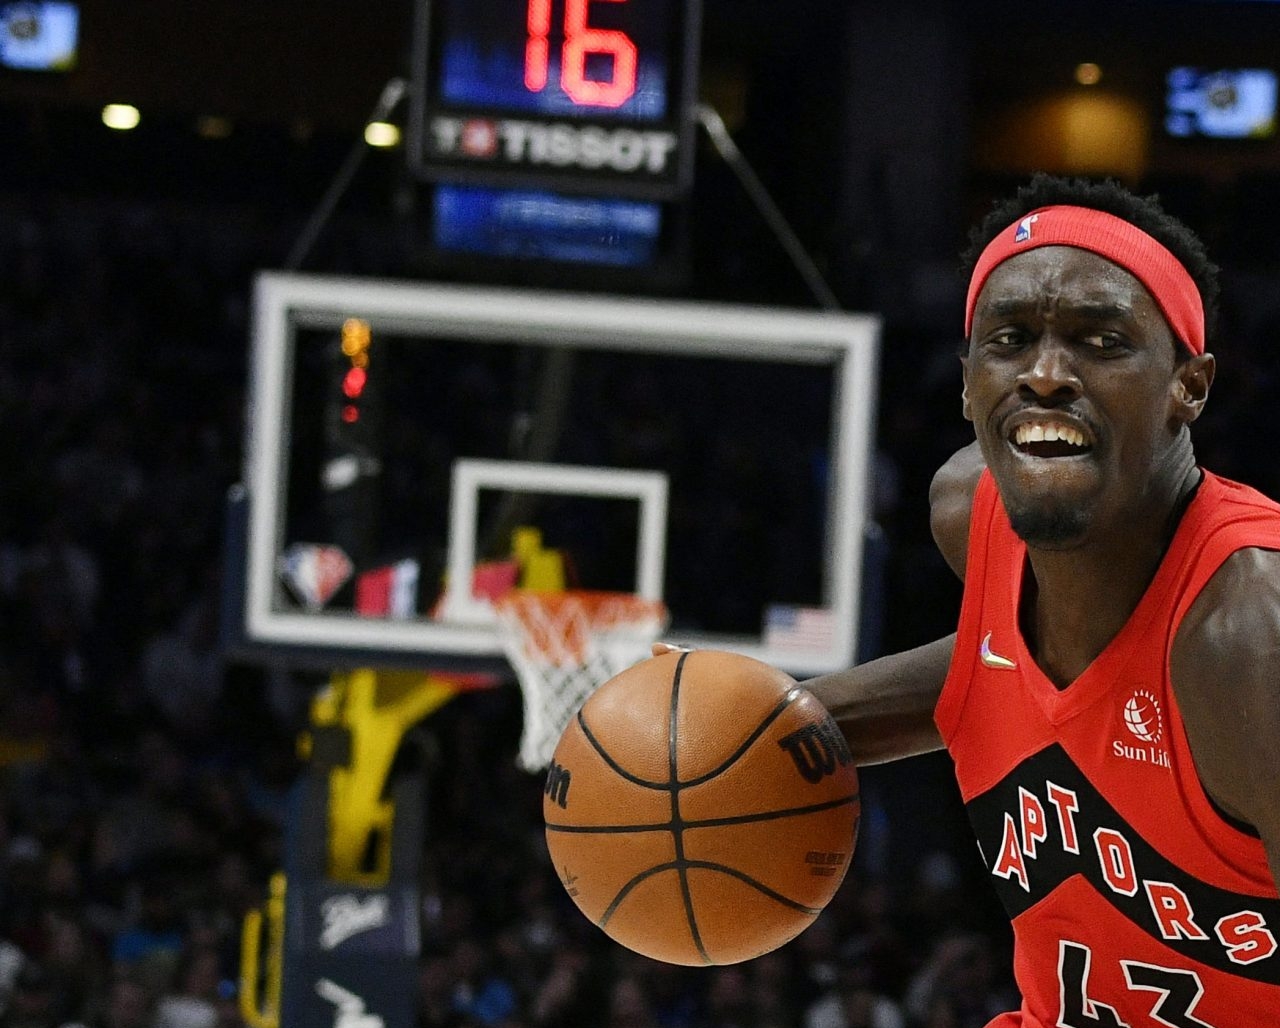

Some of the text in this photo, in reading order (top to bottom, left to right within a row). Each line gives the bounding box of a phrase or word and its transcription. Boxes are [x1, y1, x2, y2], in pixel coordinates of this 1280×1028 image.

[523, 0, 637, 107] 16
[501, 119, 677, 173] TISSOT
[1112, 740, 1147, 762] Sun
[977, 779, 1278, 966] APTORS
